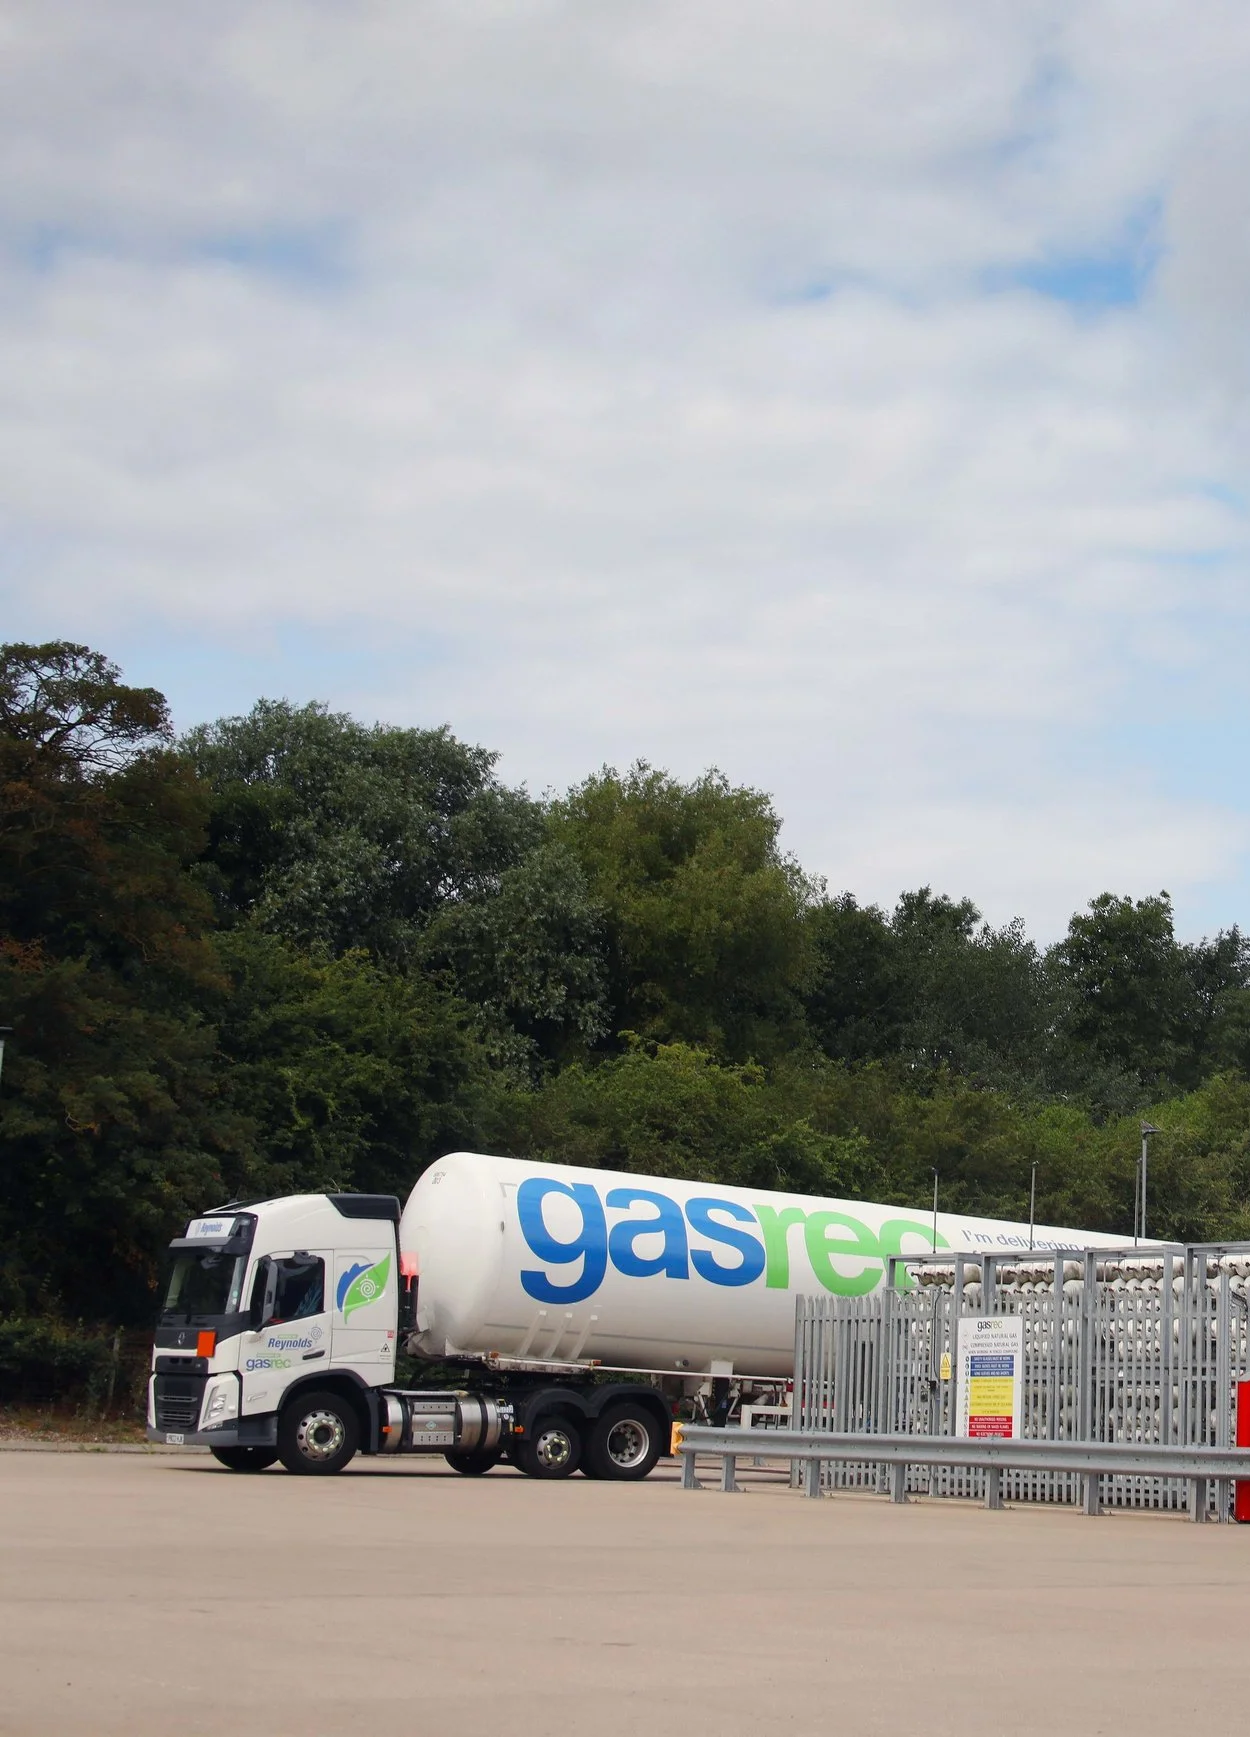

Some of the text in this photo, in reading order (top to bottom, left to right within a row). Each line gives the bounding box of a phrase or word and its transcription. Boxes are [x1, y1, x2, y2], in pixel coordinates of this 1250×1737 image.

[516, 1177, 950, 1305] gasrec
[961, 1229, 993, 1244] I'm
[977, 1320, 1003, 1332] gasrec
[267, 1338, 313, 1351] Reynolds
[246, 1358, 292, 1371] gasrec
